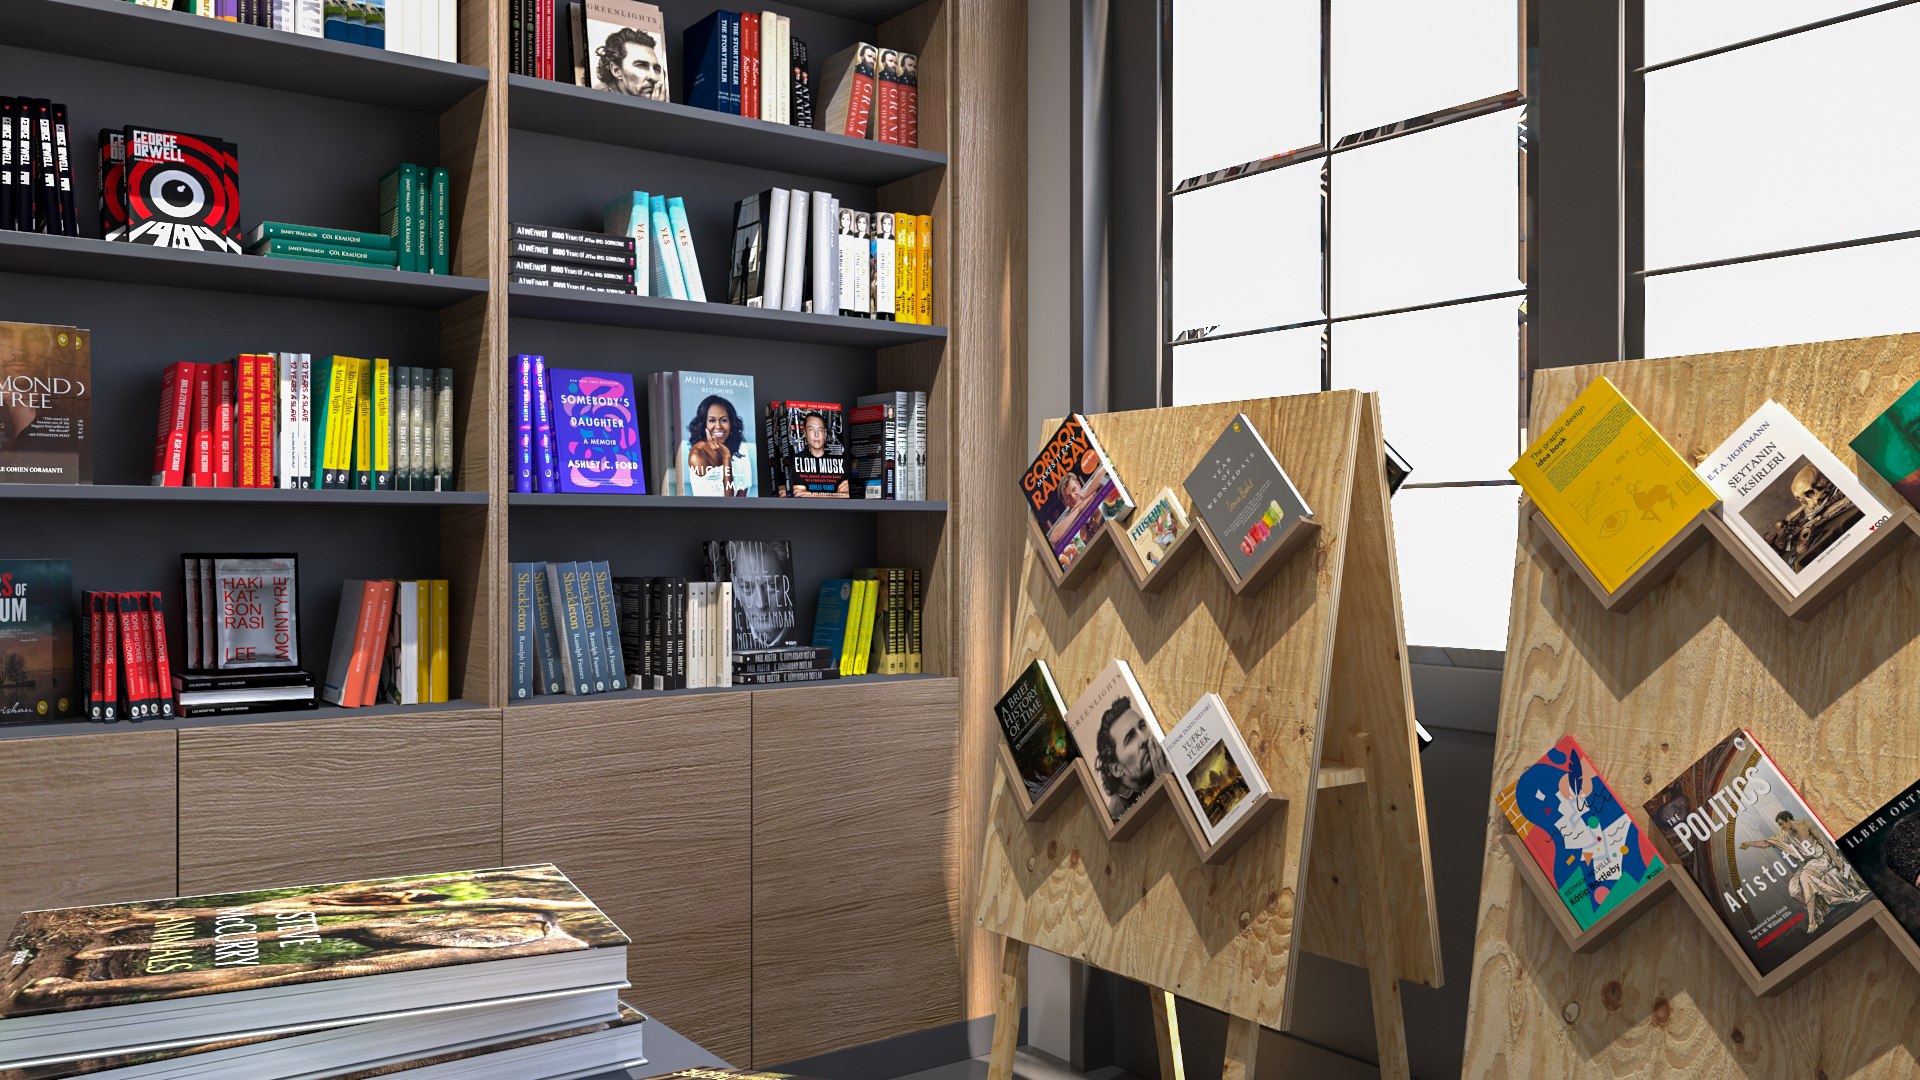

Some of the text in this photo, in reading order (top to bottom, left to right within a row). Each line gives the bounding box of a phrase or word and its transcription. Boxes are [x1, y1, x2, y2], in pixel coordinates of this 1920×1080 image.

[586, 3, 658, 25] GREENLIGHTS
[854, 80, 862, 96] RON
[856, 83, 873, 135] GRANT
[889, 88, 898, 144] GRANT
[133, 130, 178, 149] GEORGE
[133, 143, 185, 162] ORWELL
[129, 221, 228, 252] 1984
[321, 233, 334, 241] ÇÖL
[552, 230, 565, 240] 1000
[329, 249, 341, 257] ÇÖL
[553, 247, 566, 257] 1000
[243, 361, 254, 375] THE
[260, 362, 271, 376] THE
[291, 361, 297, 369] 12
[302, 361, 308, 370] 12
[243, 377, 254, 391] POT
[260, 378, 271, 391] POT
[332, 369, 344, 415] Arabian Nights
[345, 369, 357, 416] Arabian Nights
[379, 371, 387, 417] Arabian Nights
[685, 376, 750, 389] MIJN VERHAAL
[701, 387, 734, 396] BECOMING
[243, 401, 254, 415] THE
[260, 401, 271, 415] THE
[560, 394, 630, 407] SOMEBODY'S
[243, 416, 254, 446] PALETTE
[260, 417, 271, 446] PALETTE
[571, 416, 624, 428] DAUGHTER
[897, 392, 907, 450] MINDHUNTER
[916, 392, 926, 450] MINDHUNTER
[1529, 403, 1586, 461] The graphic design
[886, 421, 895, 461] ELON MUSK
[1023, 418, 1081, 491] GORDON
[1535, 436, 1568, 469] idea book
[1707, 420, 1770, 481] E.T.A. HOFFMANN
[243, 447, 254, 486] COOKBOOK
[260, 448, 271, 486] COOKBOOK
[568, 459, 638, 470] ASHLEY C. FORD
[794, 457, 845, 474] ELON MUSK
[1031, 430, 1089, 511] RAMSAY
[1037, 435, 1076, 487] MAKES IT EASY
[1212, 456, 1232, 480] YEAR
[1221, 468, 1231, 481] OF
[1727, 441, 1778, 490] ŞEYTANIN
[1739, 450, 1786, 497] İKSİRLERİ
[1207, 452, 1255, 510] WEDNESDAYS
[726, 541, 769, 583] PAUL
[15, 583, 28, 597] OF
[223, 576, 263, 589] HAKİ
[224, 590, 259, 602] KAT-
[733, 574, 794, 609] AUSTER
[224, 603, 262, 617] SON
[518, 573, 530, 632] Shackleton
[563, 572, 579, 630] Shackleton
[580, 571, 595, 629] Shackleton
[106, 615, 114, 631] SONS
[122, 615, 131, 632] SONS
[154, 614, 162, 630] SONS
[225, 616, 265, 629] RASI
[273, 576, 289, 659] MCINTYRE
[106, 645, 114, 665] LOVERS
[225, 646, 257, 661] LEE
[1000, 680, 1030, 718] A BRIEF
[1004, 685, 1038, 729] HISTORY
[1071, 673, 1122, 733] GREENLIGHTS
[1009, 720, 1021, 738] OF
[1020, 698, 1042, 726] TIME
[1182, 726, 1207, 752] YUFKA
[1187, 734, 1211, 760] YÜREK
[1666, 812, 1681, 827] THE
[1673, 766, 1772, 853] POLITICS
[1845, 816, 1887, 849] İLBER
[1564, 878, 1587, 898] HERMAN
[1588, 863, 1621, 891] Bartleby
[1723, 839, 1816, 913] Aristotle
[214, 906, 260, 967] McCURRY
[275, 911, 322, 948] STEVE
[1748, 919, 1768, 935] Translated
[1766, 913, 1777, 923] from
[146, 915, 197, 974] ANIMALS
